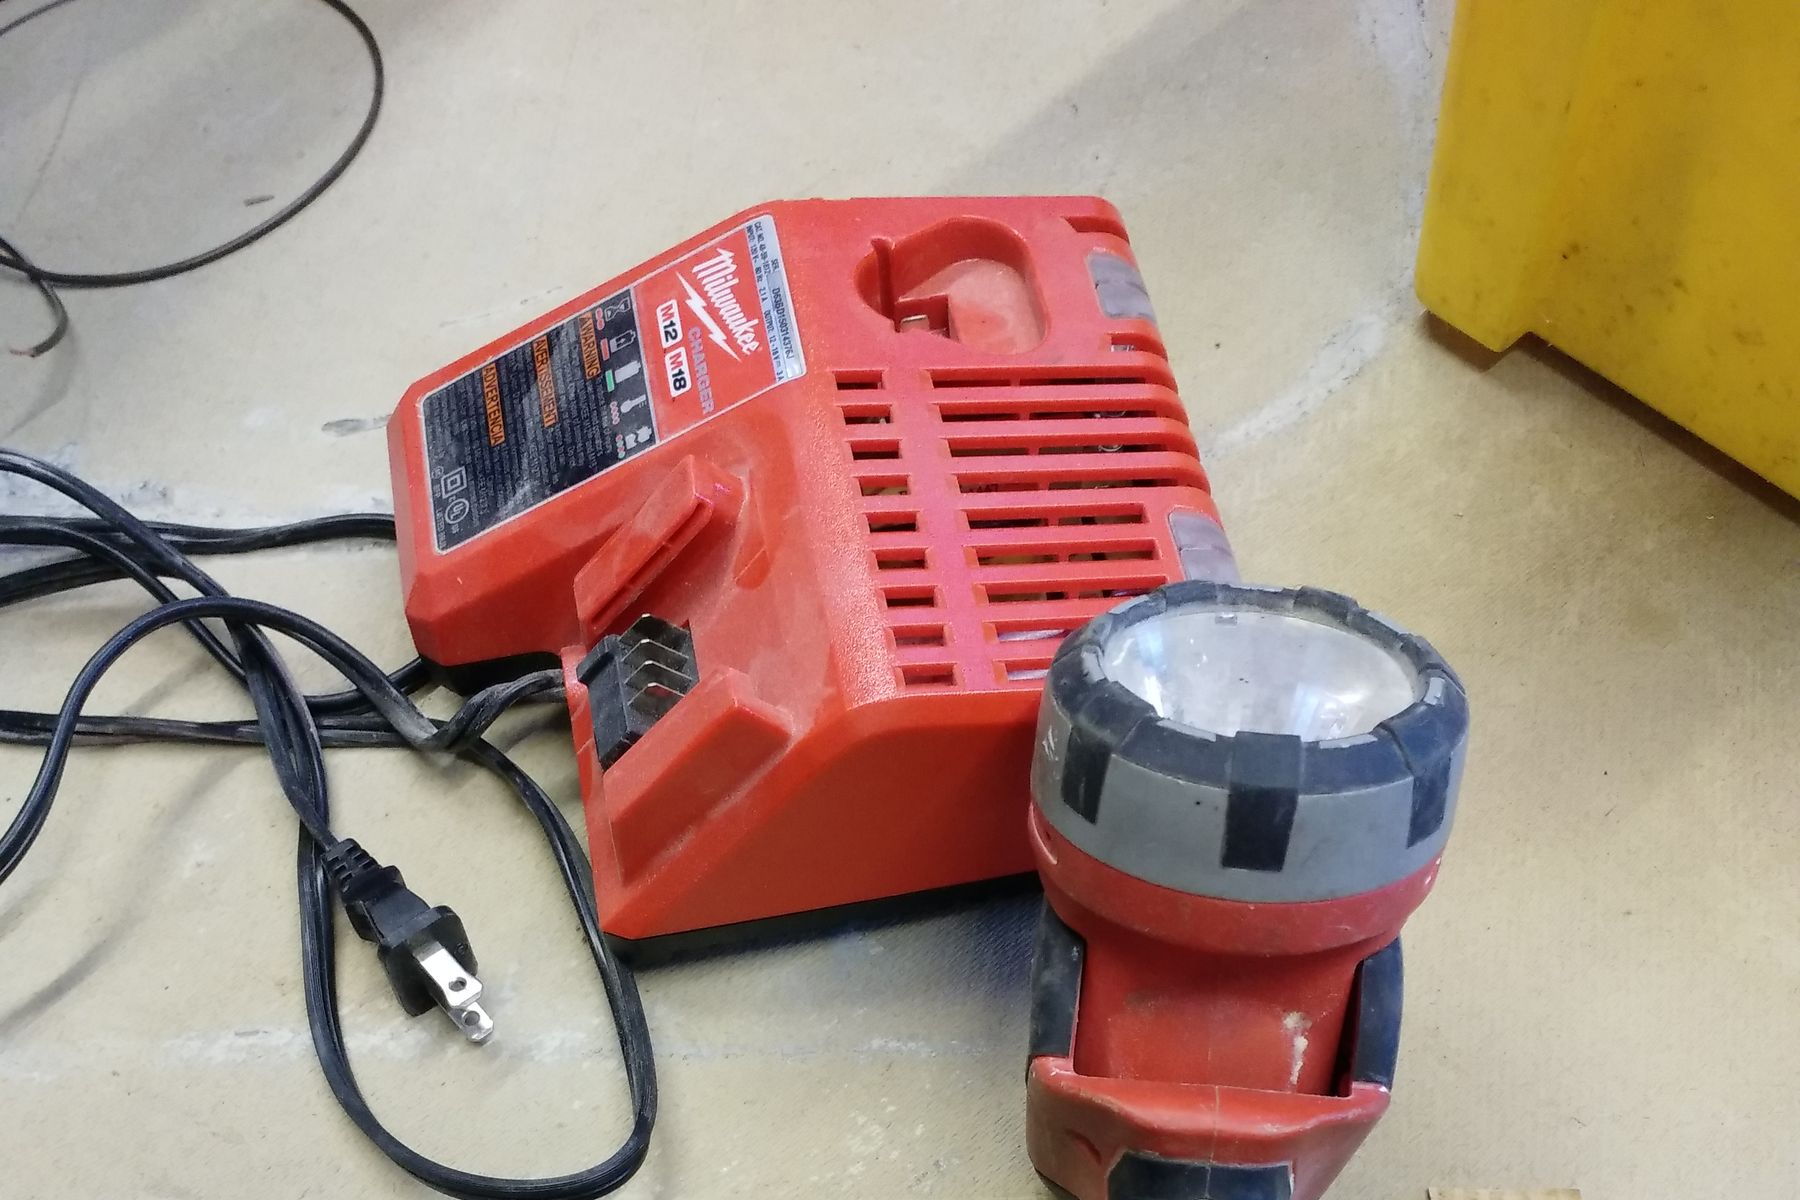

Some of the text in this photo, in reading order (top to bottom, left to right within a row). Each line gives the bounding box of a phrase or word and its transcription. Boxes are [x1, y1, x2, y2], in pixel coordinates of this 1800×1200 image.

[692, 247, 760, 356] Milwaukee
[534, 338, 557, 425] AVERTISSEMENT
[580, 321, 599, 378] WARNING
[660, 303, 687, 392] M12 M18
[687, 326, 715, 415] CHARGER
[484, 365, 504, 445] ADVERTENCIA
